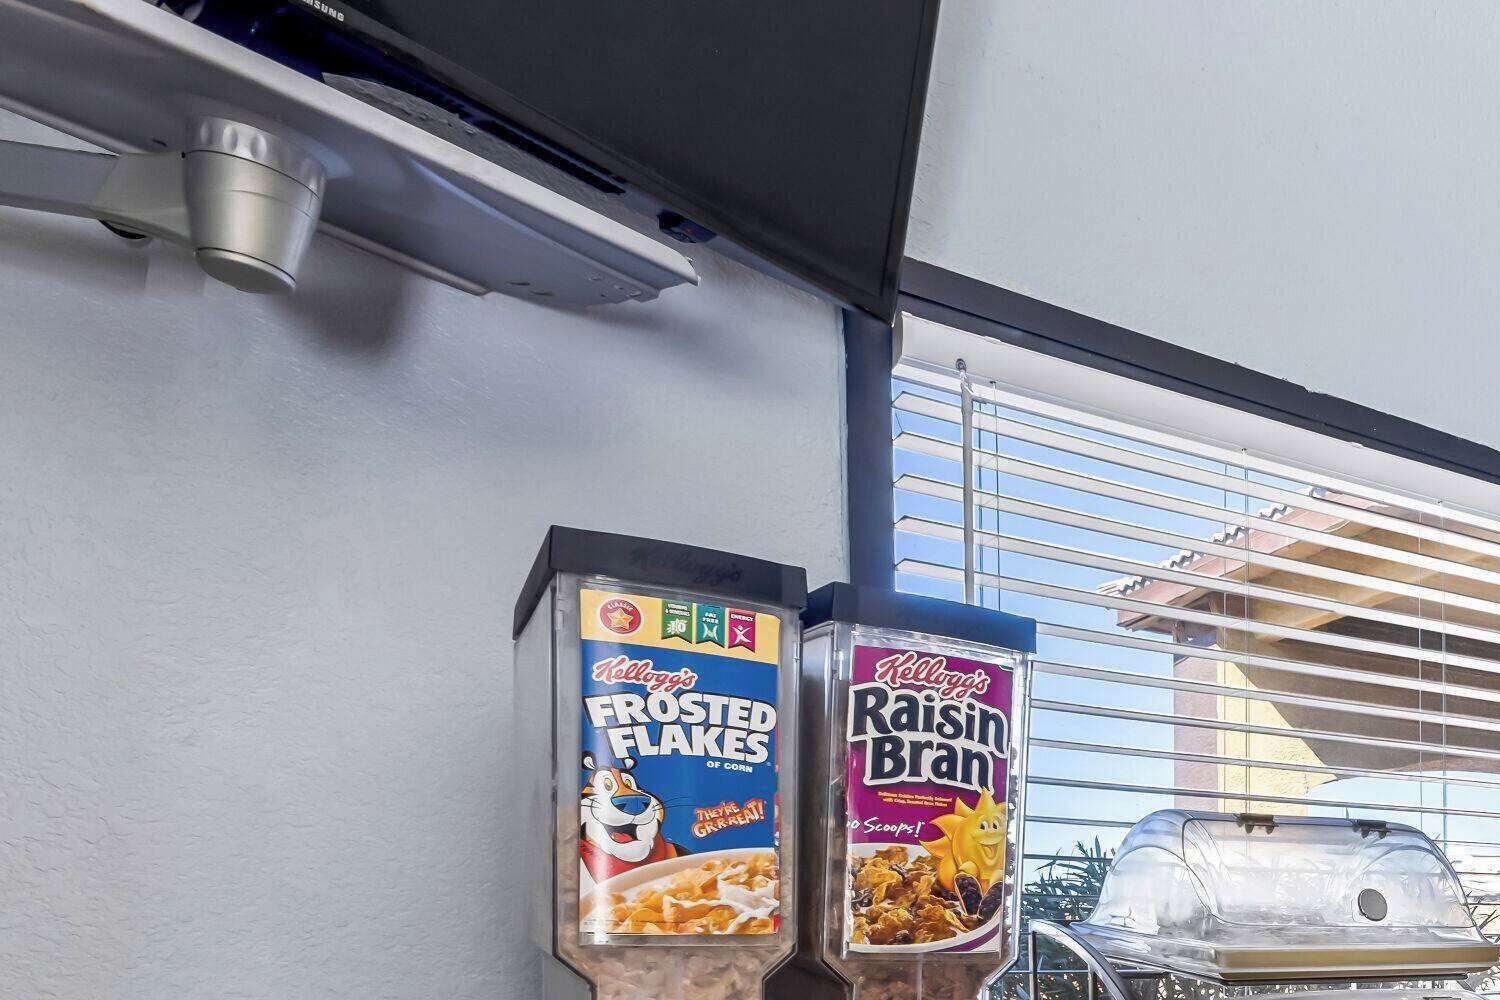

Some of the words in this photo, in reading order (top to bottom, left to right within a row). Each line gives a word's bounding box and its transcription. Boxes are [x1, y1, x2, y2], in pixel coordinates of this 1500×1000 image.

[730, 613, 754, 622] ENERGY
[593, 655, 697, 693] Kellogg's
[875, 652, 990, 701] Kellogg's
[585, 690, 777, 733] FROSTED
[851, 686, 1005, 755] Raisin
[606, 724, 769, 764] FLAKES
[868, 735, 990, 790] Bran
[706, 760, 721, 769] OF
[723, 762, 753, 773] CORN
[863, 816, 923, 838] Scoops!
